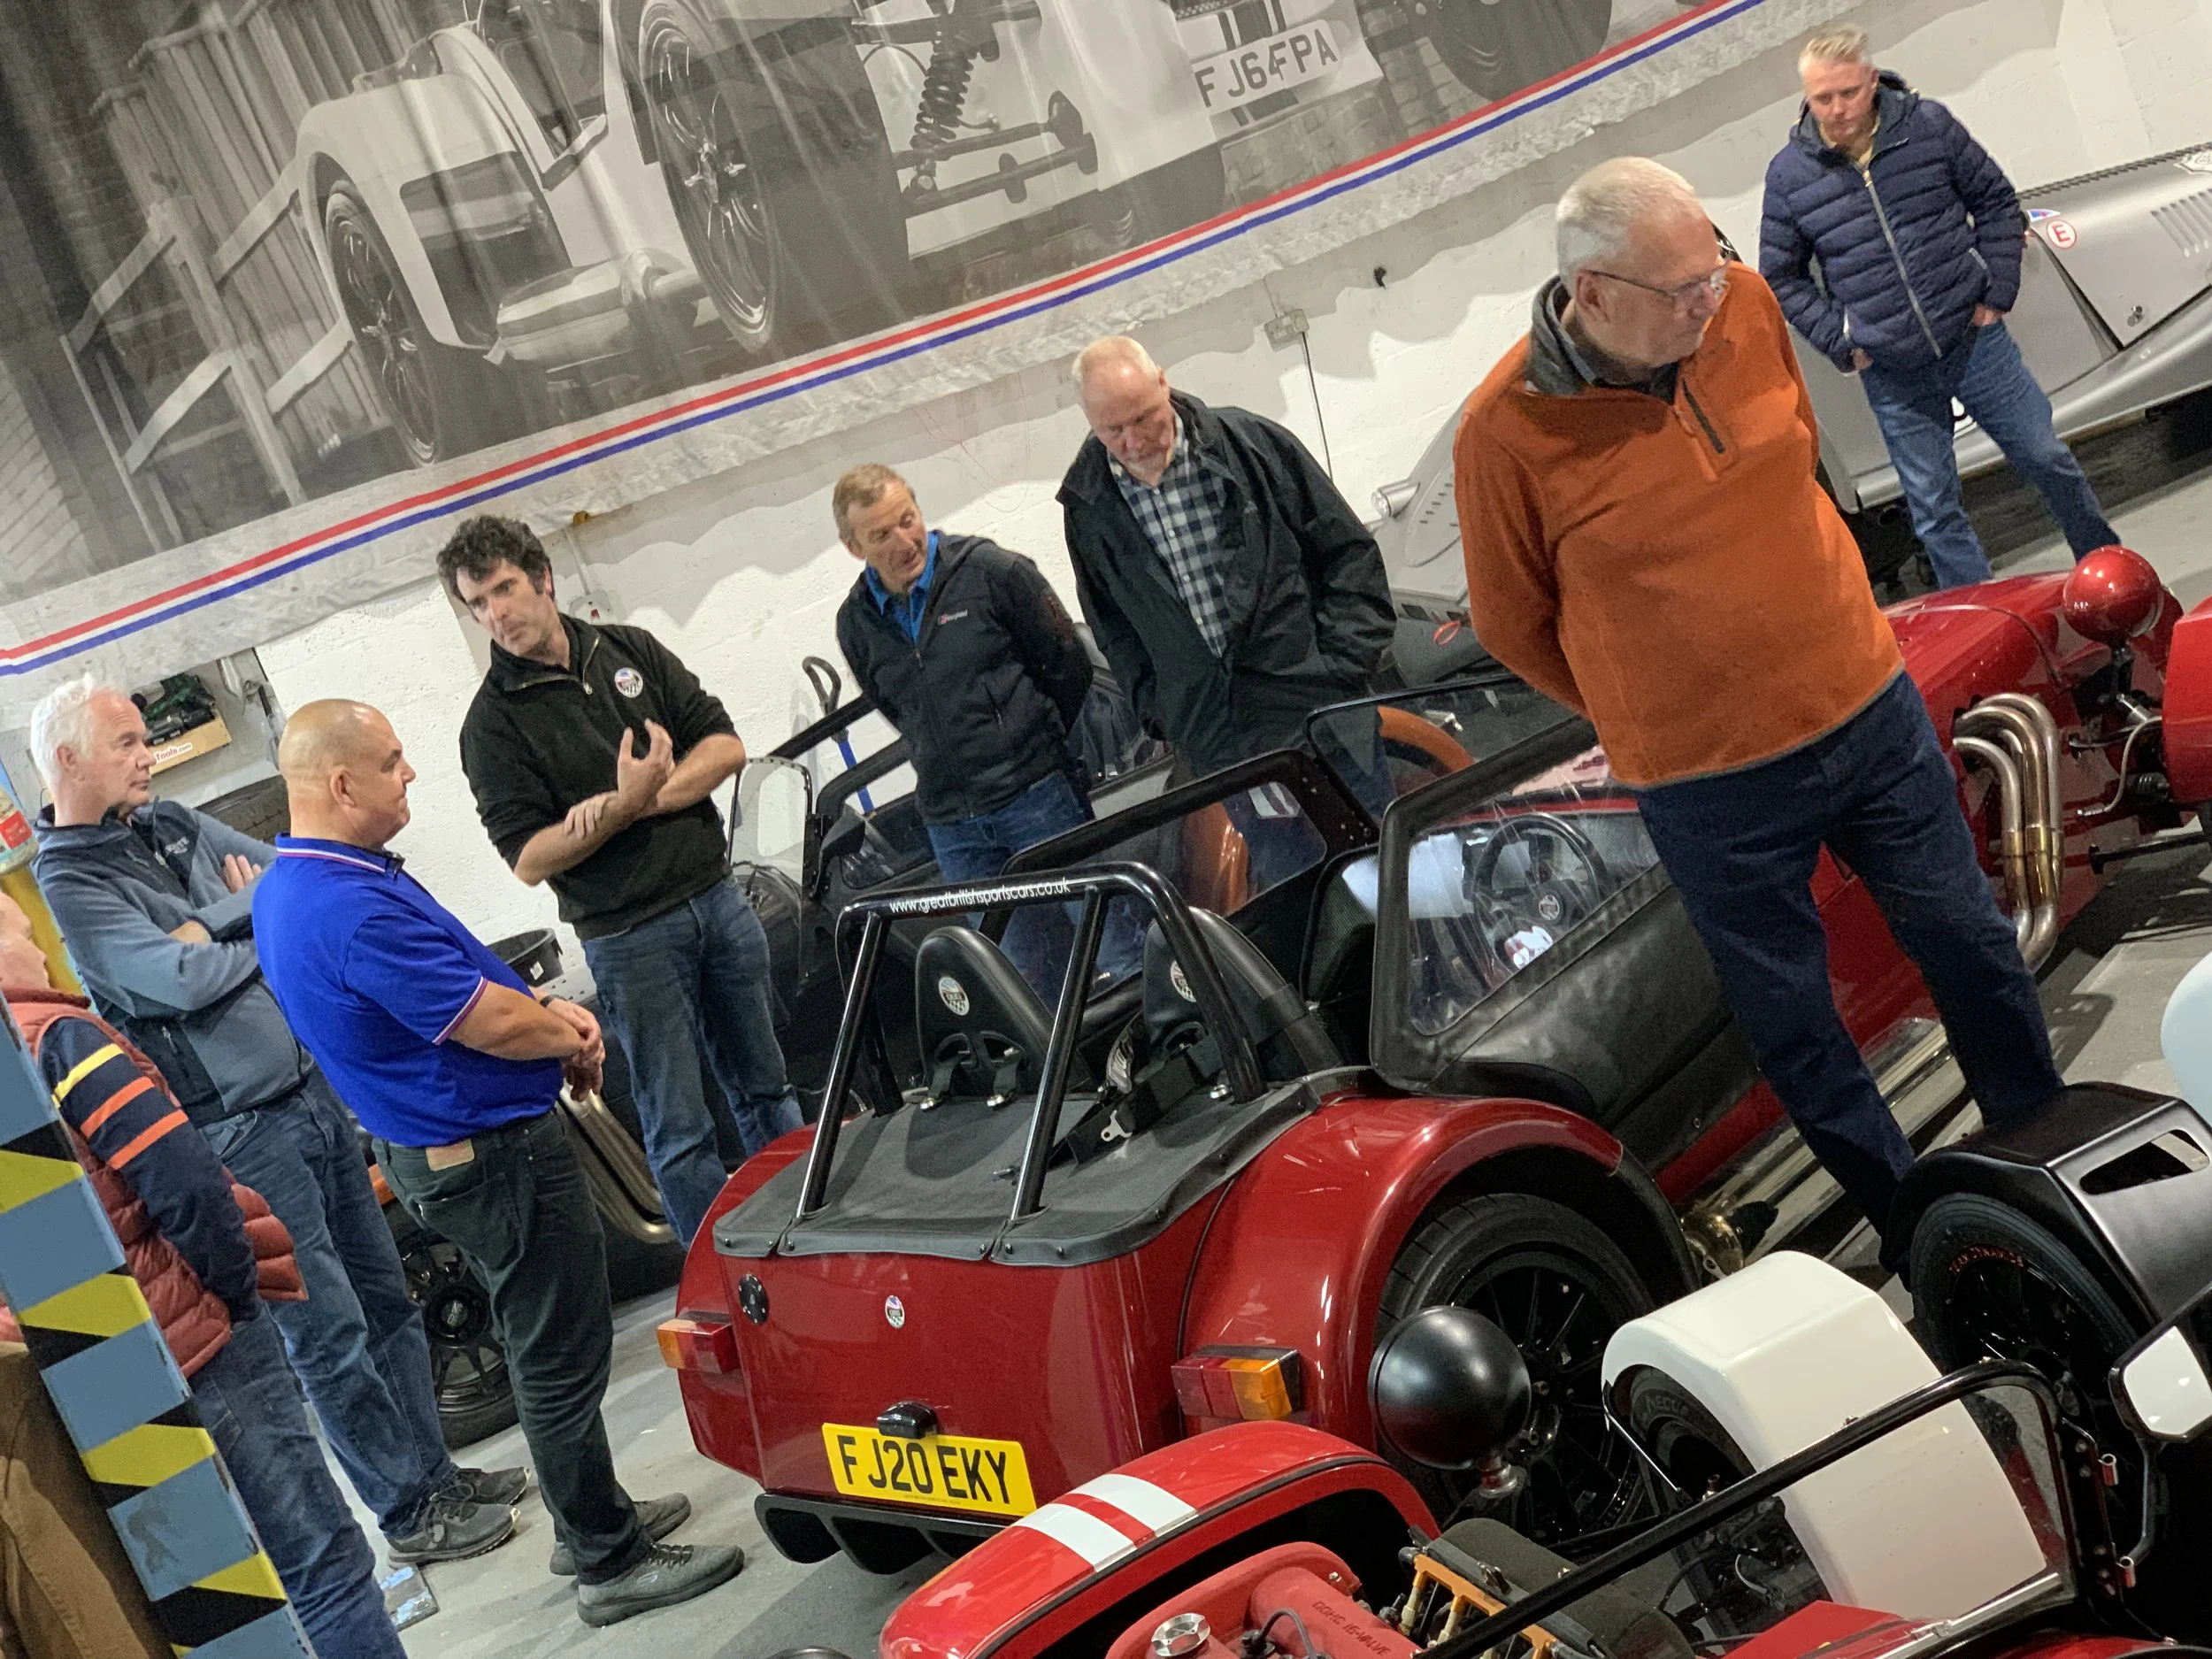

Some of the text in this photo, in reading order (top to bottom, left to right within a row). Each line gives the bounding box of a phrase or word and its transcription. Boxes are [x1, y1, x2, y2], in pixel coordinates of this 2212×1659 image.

[2052, 224, 2071, 243] E
[889, 874, 1071, 914] www.greatbritishsportscars.co.uk
[837, 1435, 1010, 1504] FJ20 EKY
[1312, 1601, 1346, 1624] DOHC
